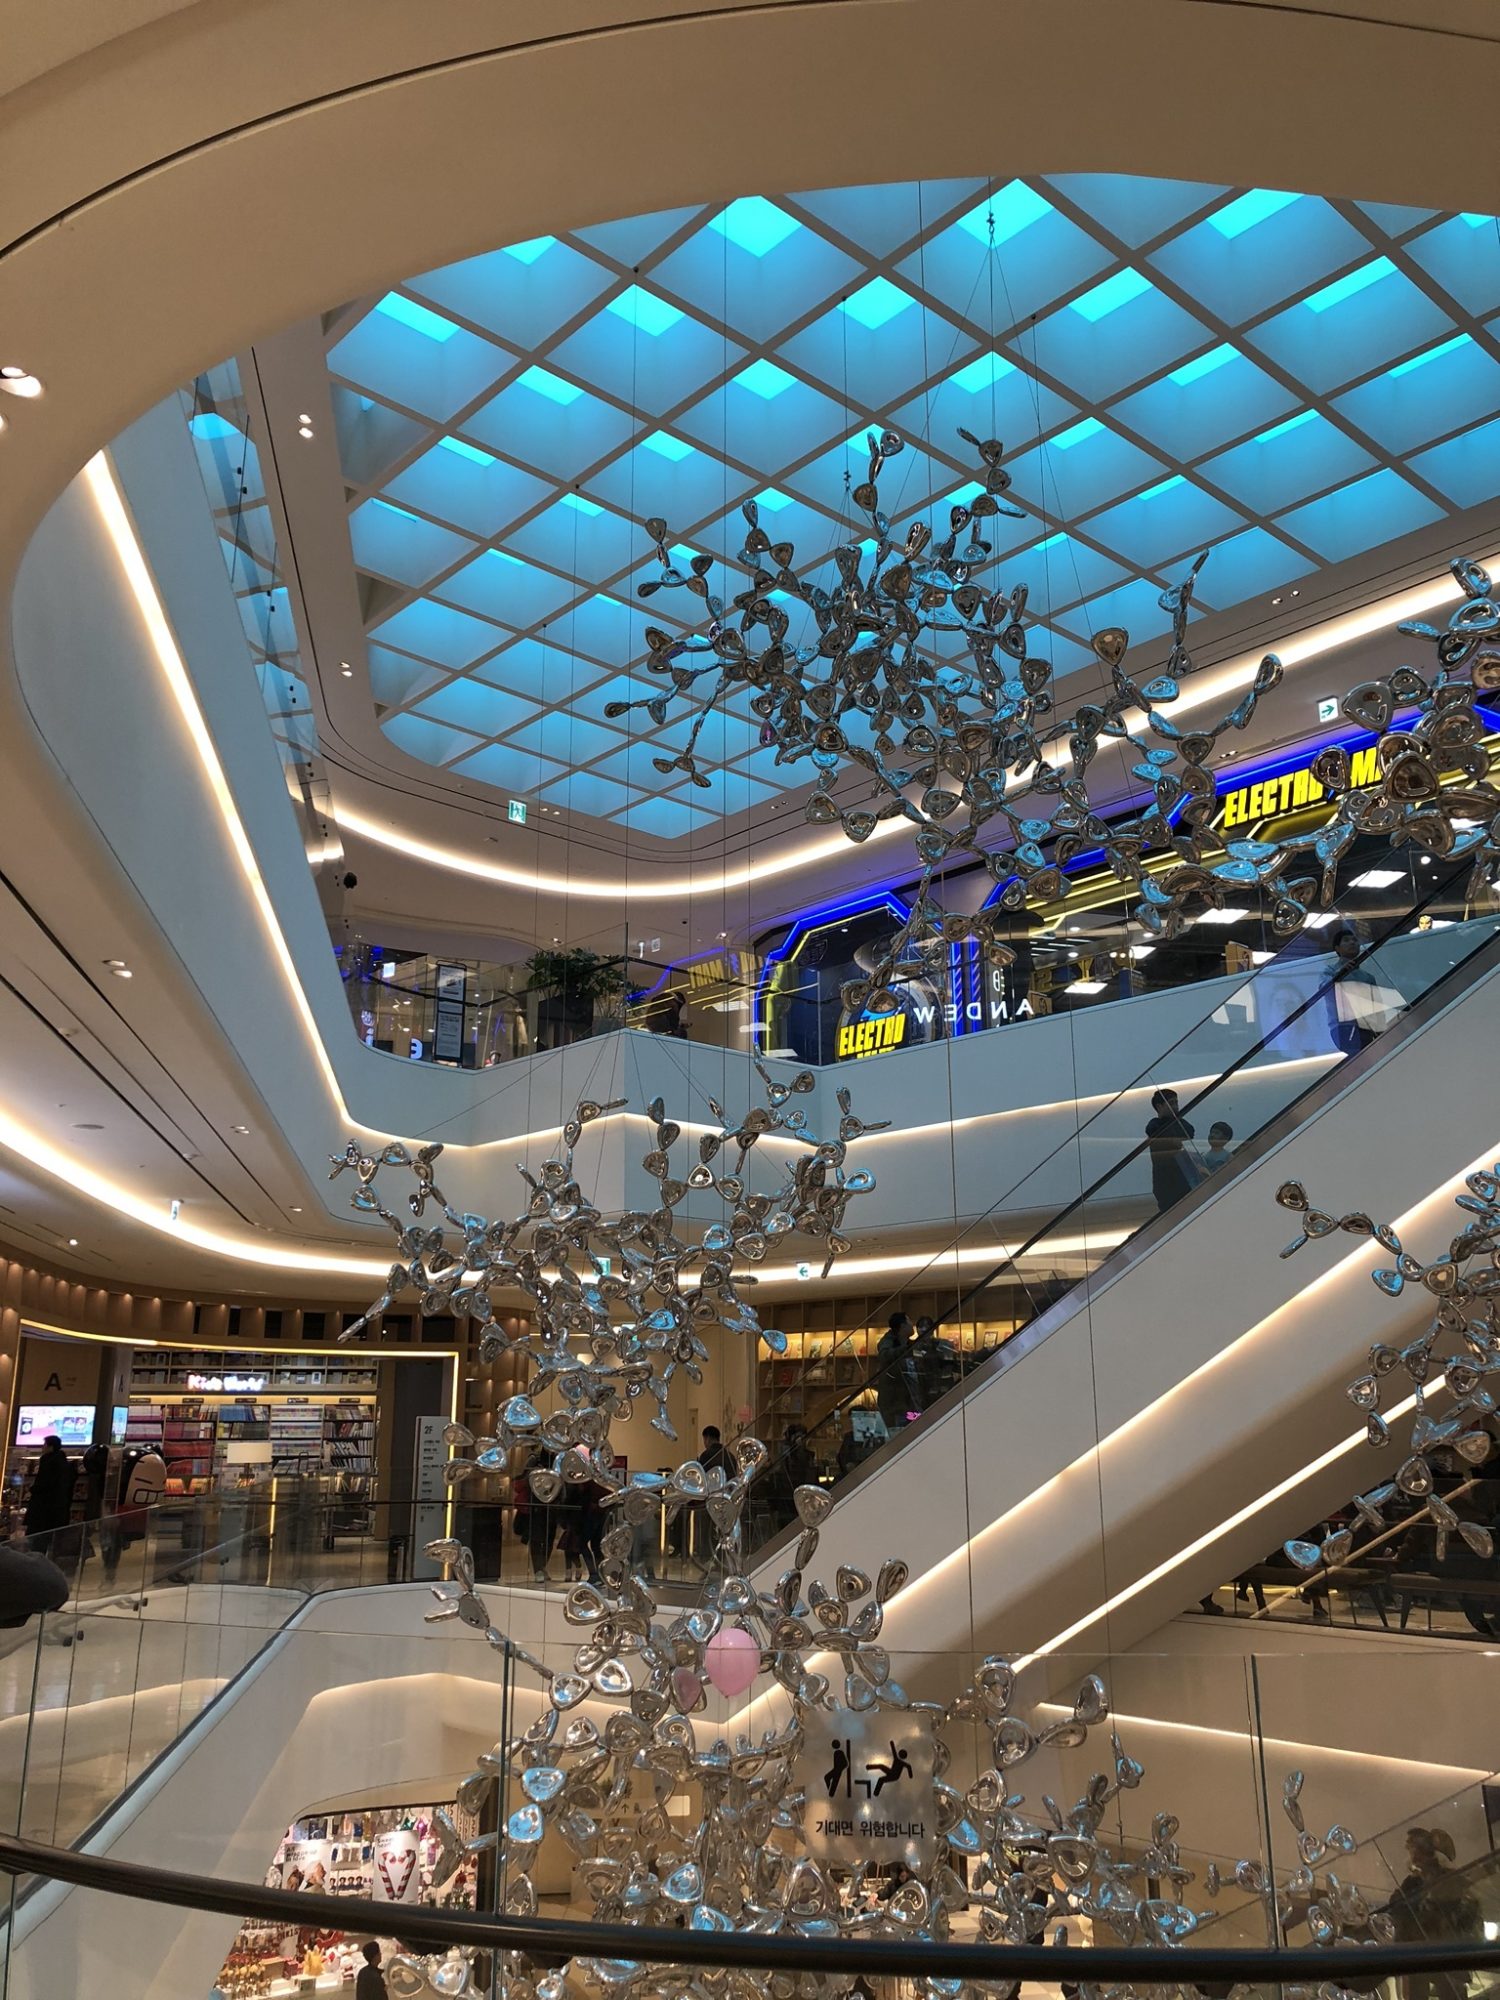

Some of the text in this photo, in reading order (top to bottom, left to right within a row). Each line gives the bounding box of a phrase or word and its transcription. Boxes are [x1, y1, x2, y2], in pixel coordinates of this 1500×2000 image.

[838, 1013, 906, 1056] ELECTRO
[44, 1373, 62, 1391] A
[424, 1425, 434, 1435] 2F
[815, 1819, 926, 1839] 기대면 위험합니다
